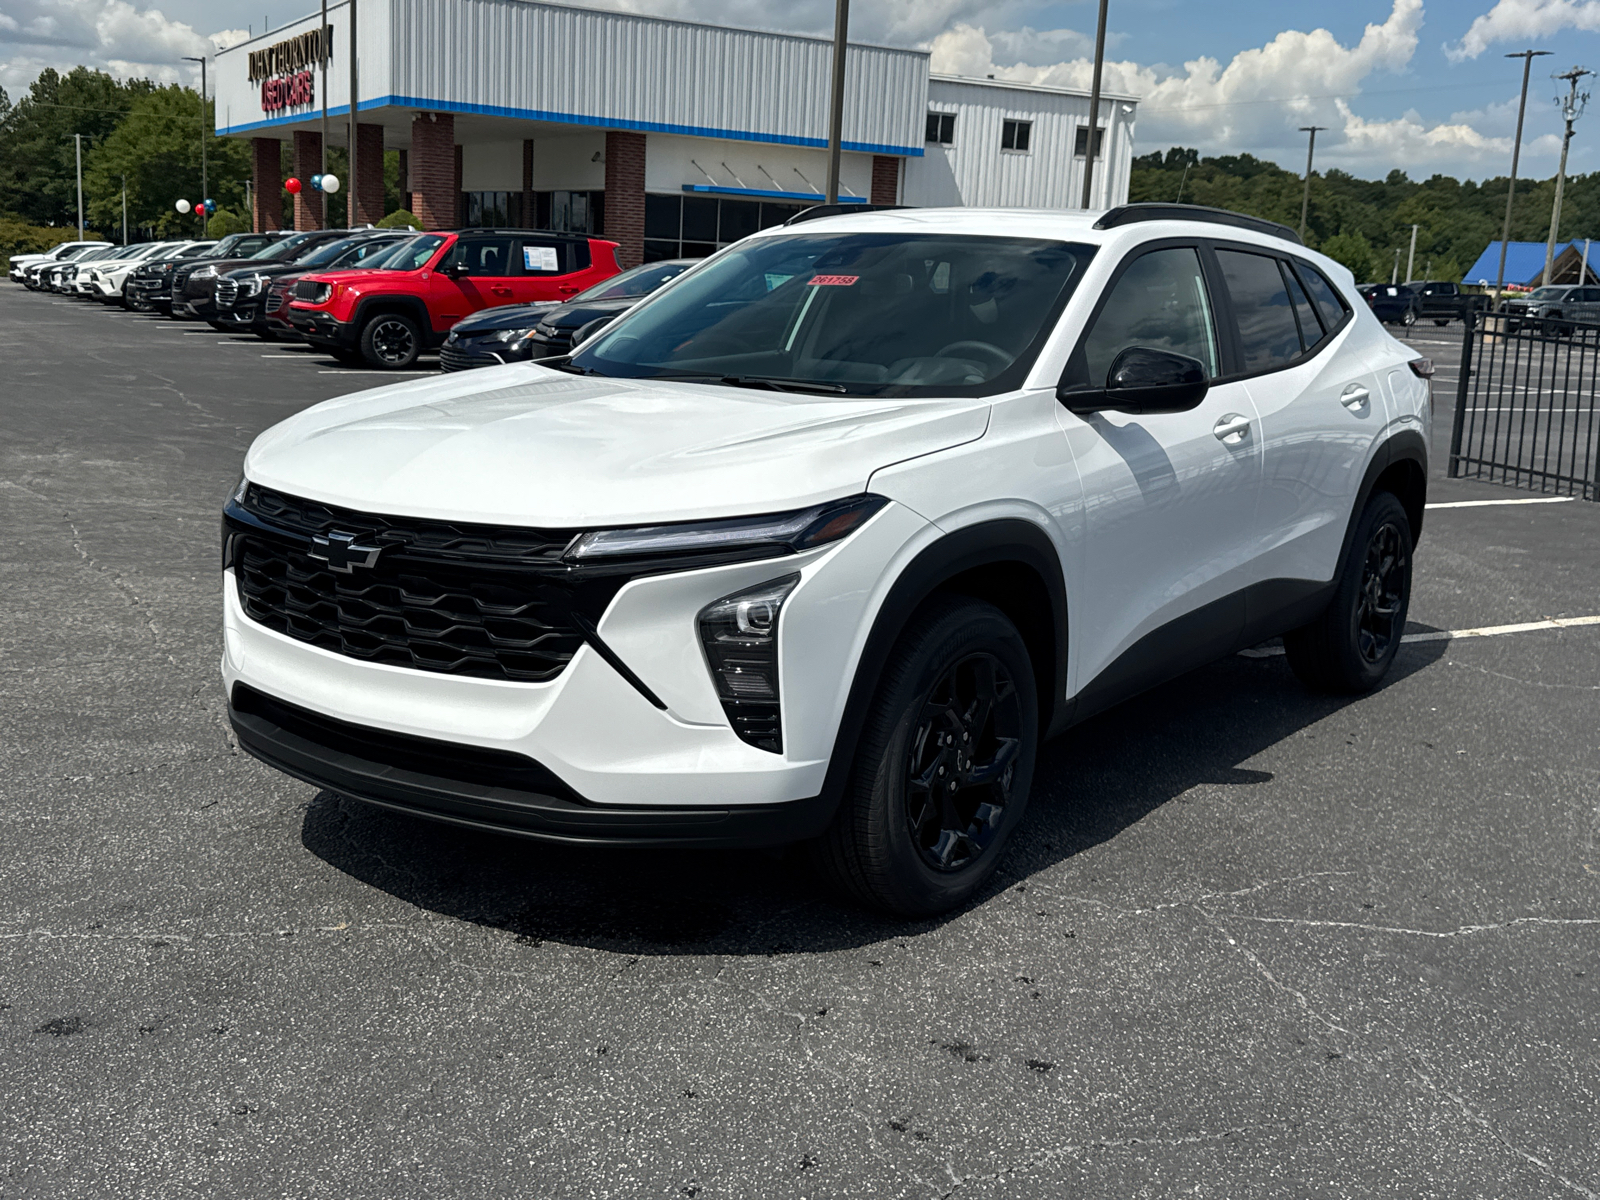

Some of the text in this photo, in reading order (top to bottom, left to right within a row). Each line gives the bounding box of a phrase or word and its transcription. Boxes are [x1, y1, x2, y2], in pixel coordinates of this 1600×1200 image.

[248, 48, 271, 81] JOHN
[261, 70, 312, 112] USED CARS
[811, 276, 855, 284] 261758
